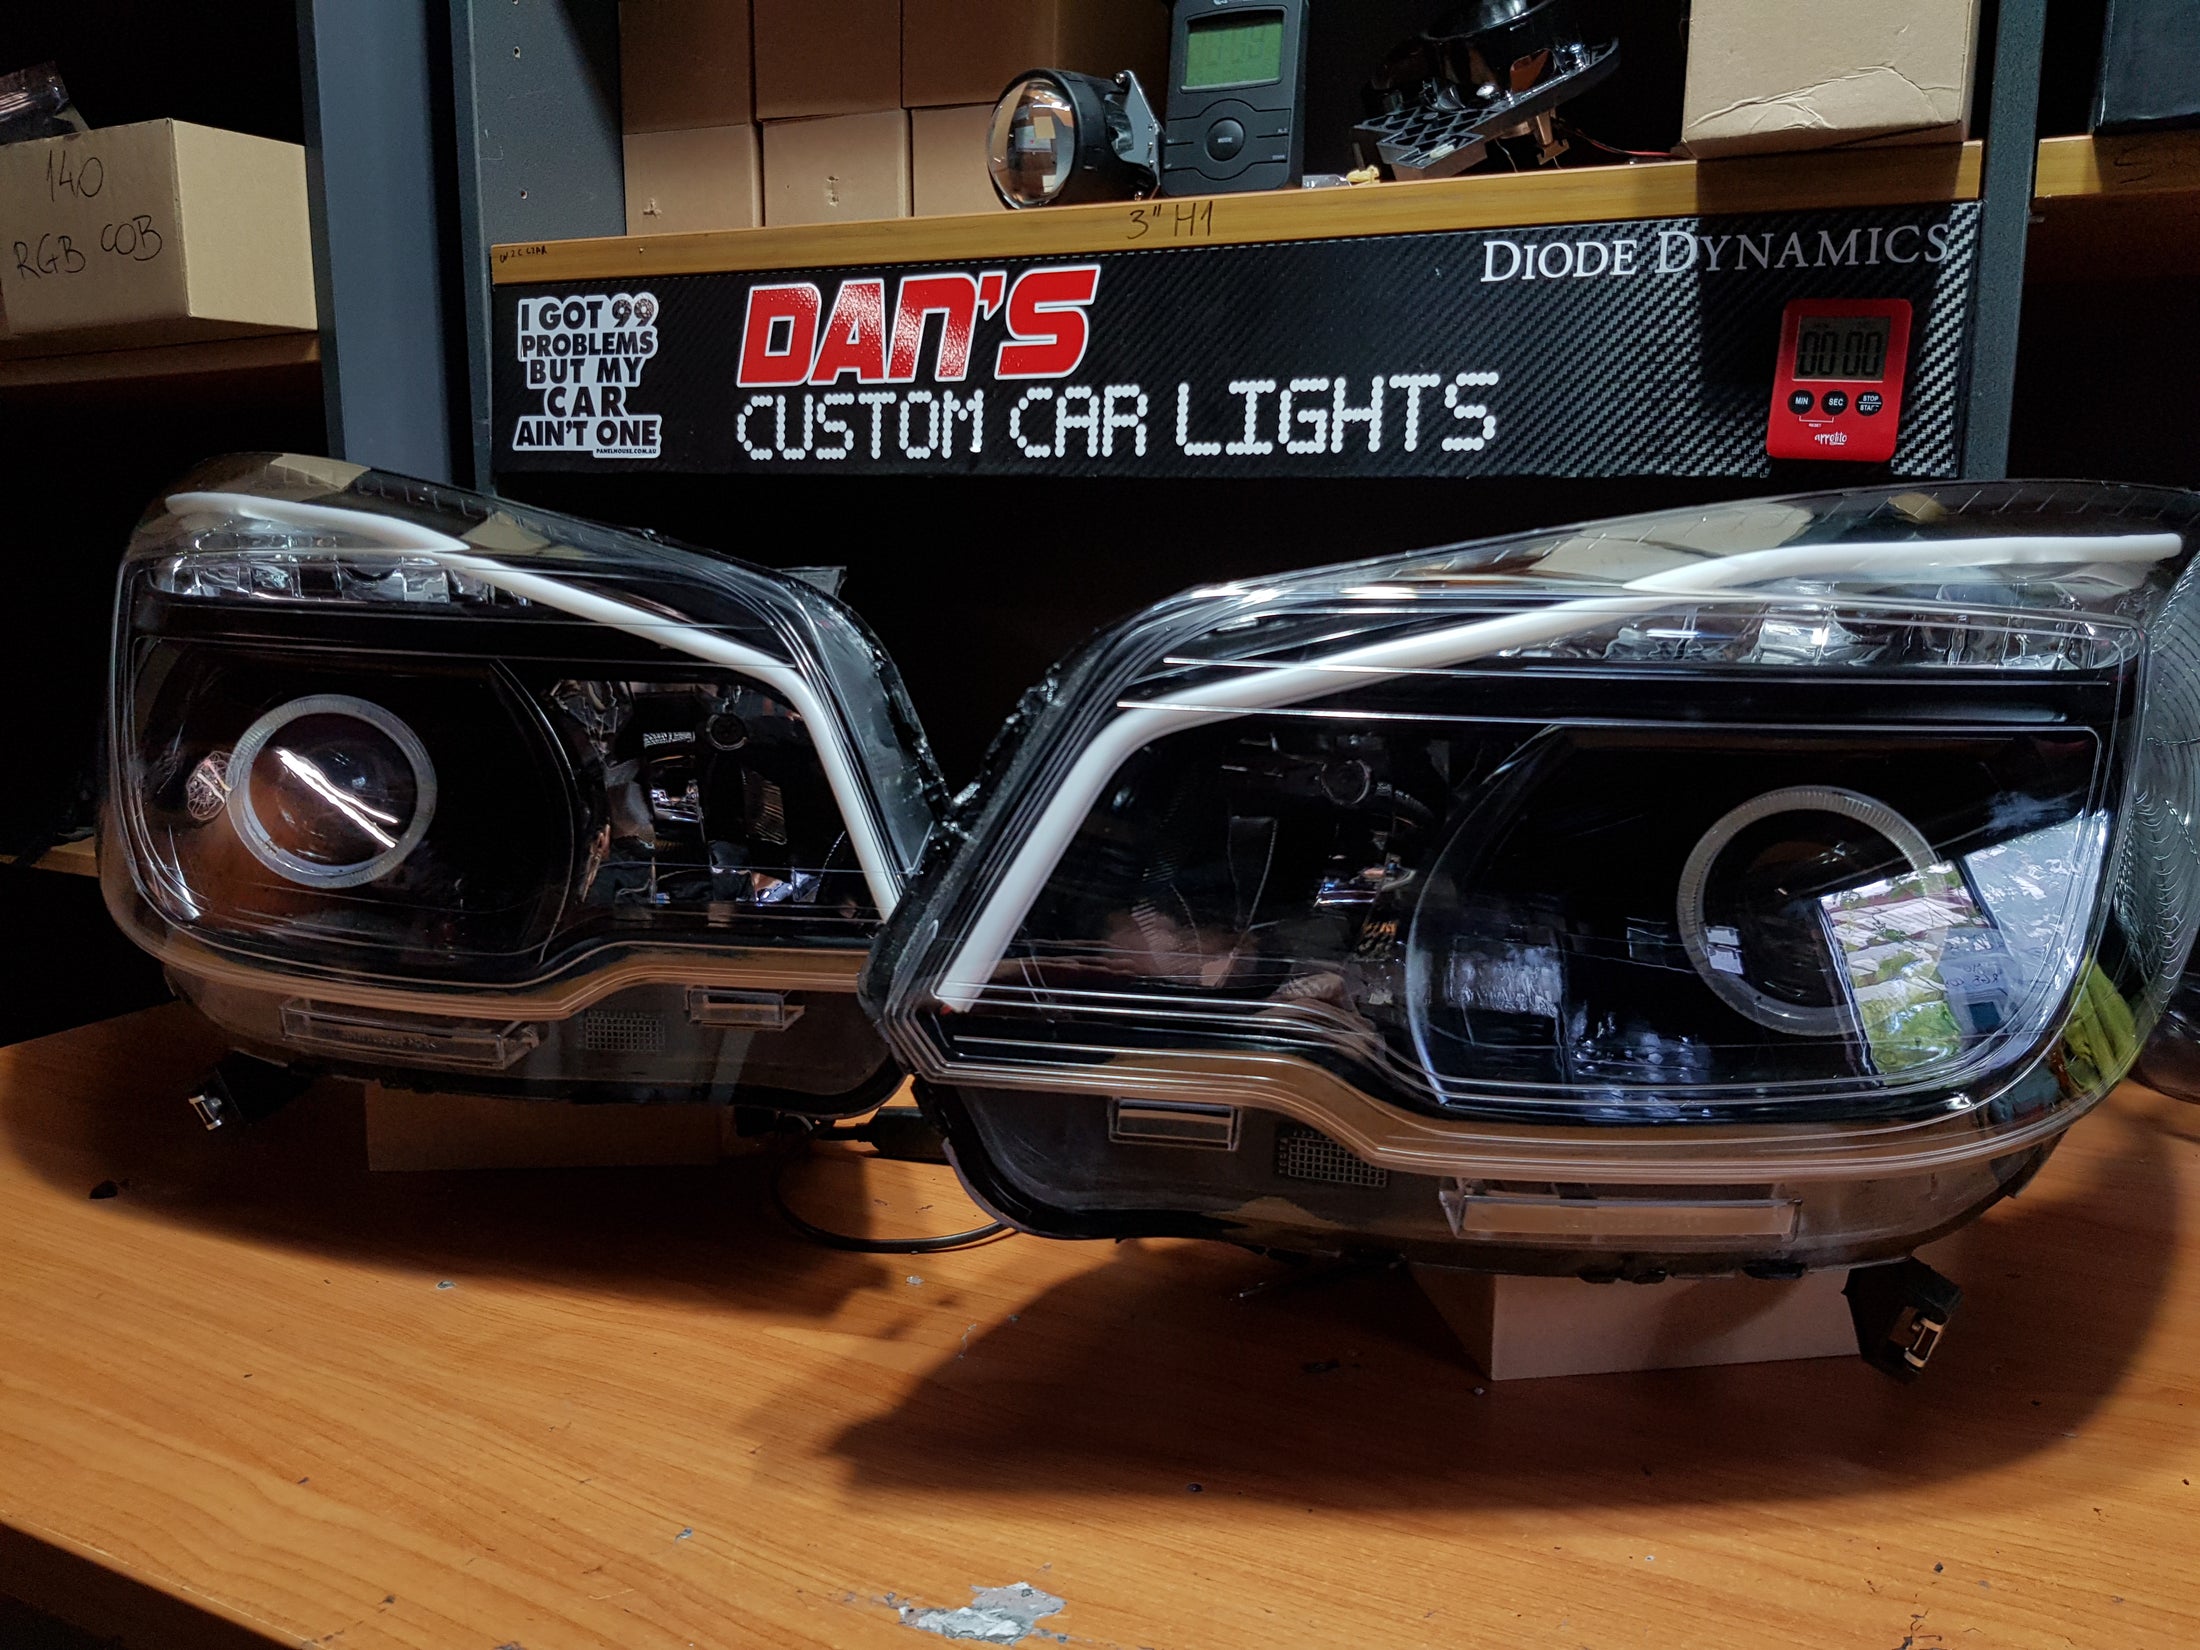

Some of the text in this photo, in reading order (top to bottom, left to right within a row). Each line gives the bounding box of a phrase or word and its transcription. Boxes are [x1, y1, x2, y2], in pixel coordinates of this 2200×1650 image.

[46, 150, 104, 203] 140
[1174, 200, 1213, 237] H1
[13, 214, 163, 280] RGB COB
[1480, 224, 1950, 282] DIODE DYNAMICS
[520, 297, 656, 331] I GOT 99
[736, 264, 1100, 388] DAN'S
[521, 331, 654, 358] PROBLEMS
[530, 356, 644, 385] BUT MY
[546, 386, 624, 418] CAR
[737, 371, 1500, 460] CUSTOM CAR LIGHTS
[1795, 395, 1879, 407] MIN SEC STOP
[515, 419, 658, 447] AIN'T ONE
